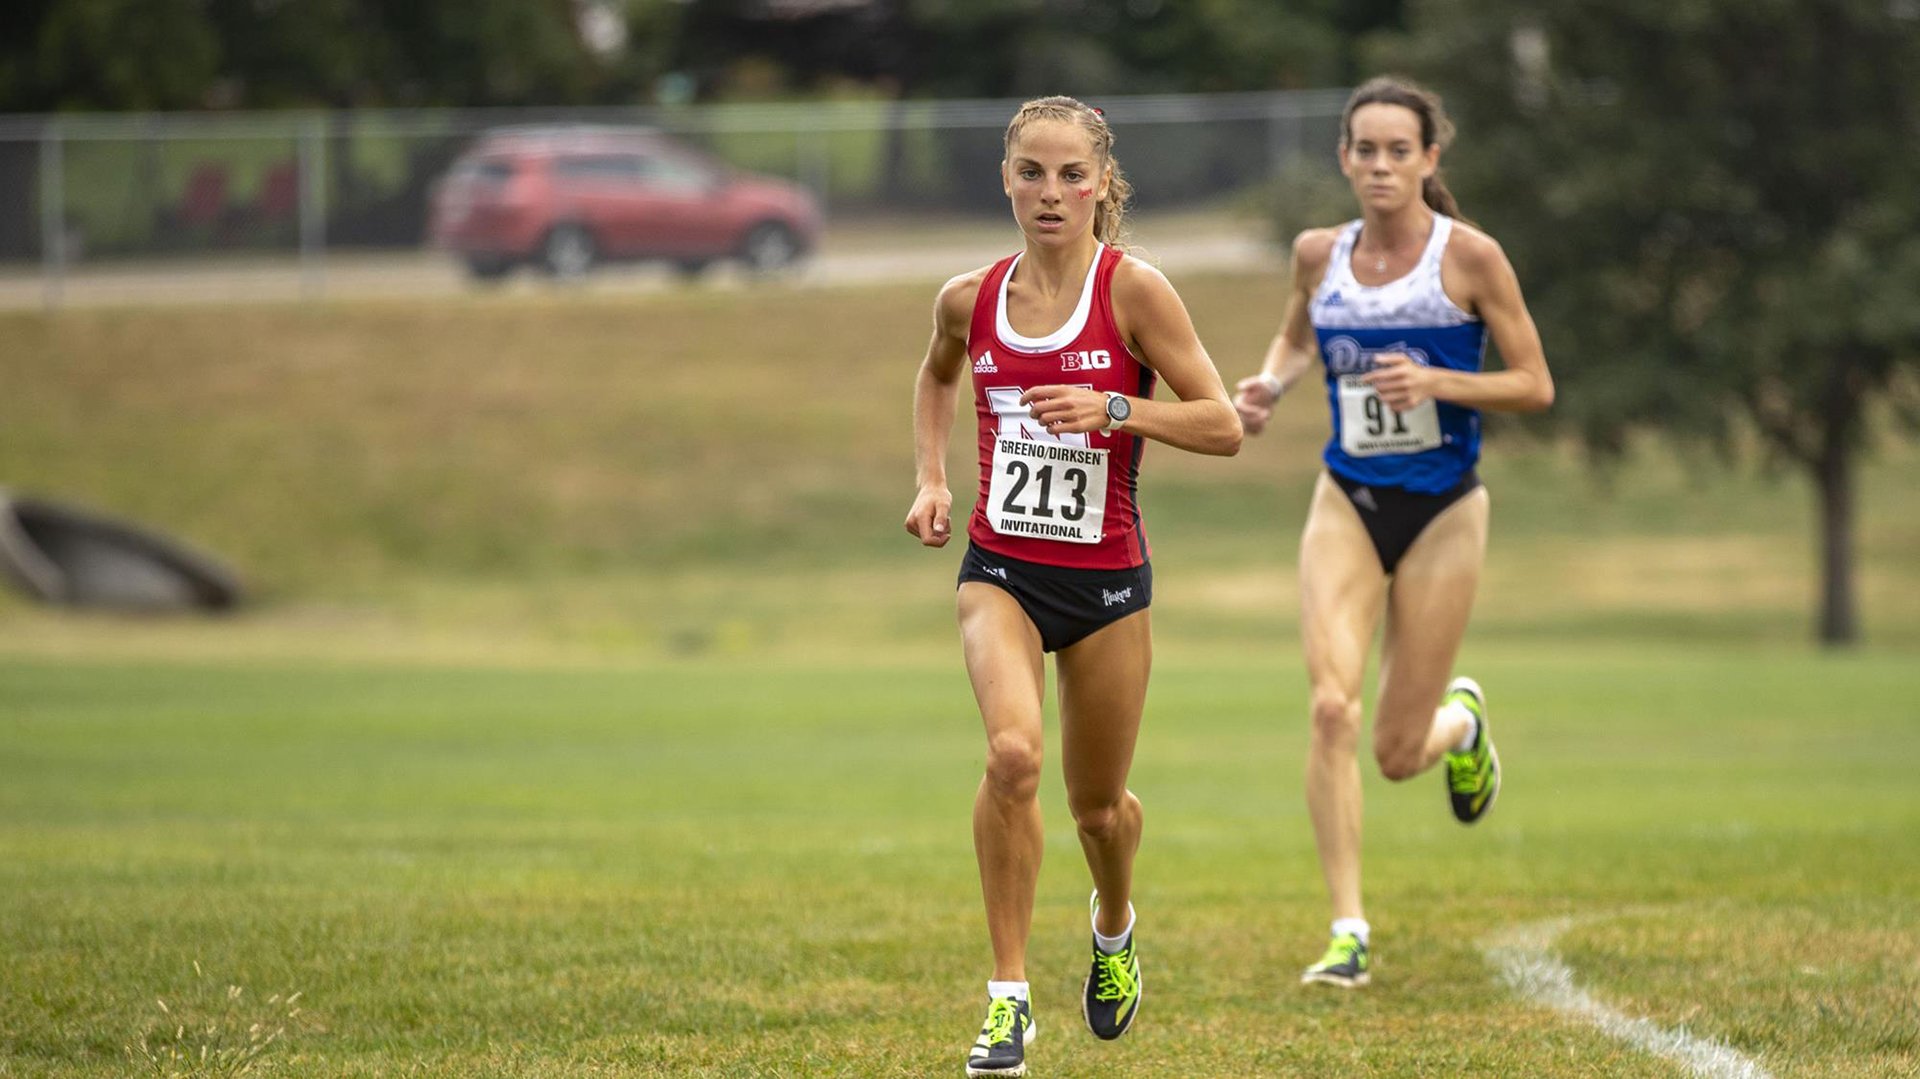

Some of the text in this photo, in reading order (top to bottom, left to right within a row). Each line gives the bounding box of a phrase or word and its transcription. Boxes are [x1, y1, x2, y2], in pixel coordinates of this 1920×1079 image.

[1365, 394, 1408, 436] 91
[1002, 460, 1087, 521] 213
[1000, 518, 1083, 539] INVITATIONAL
